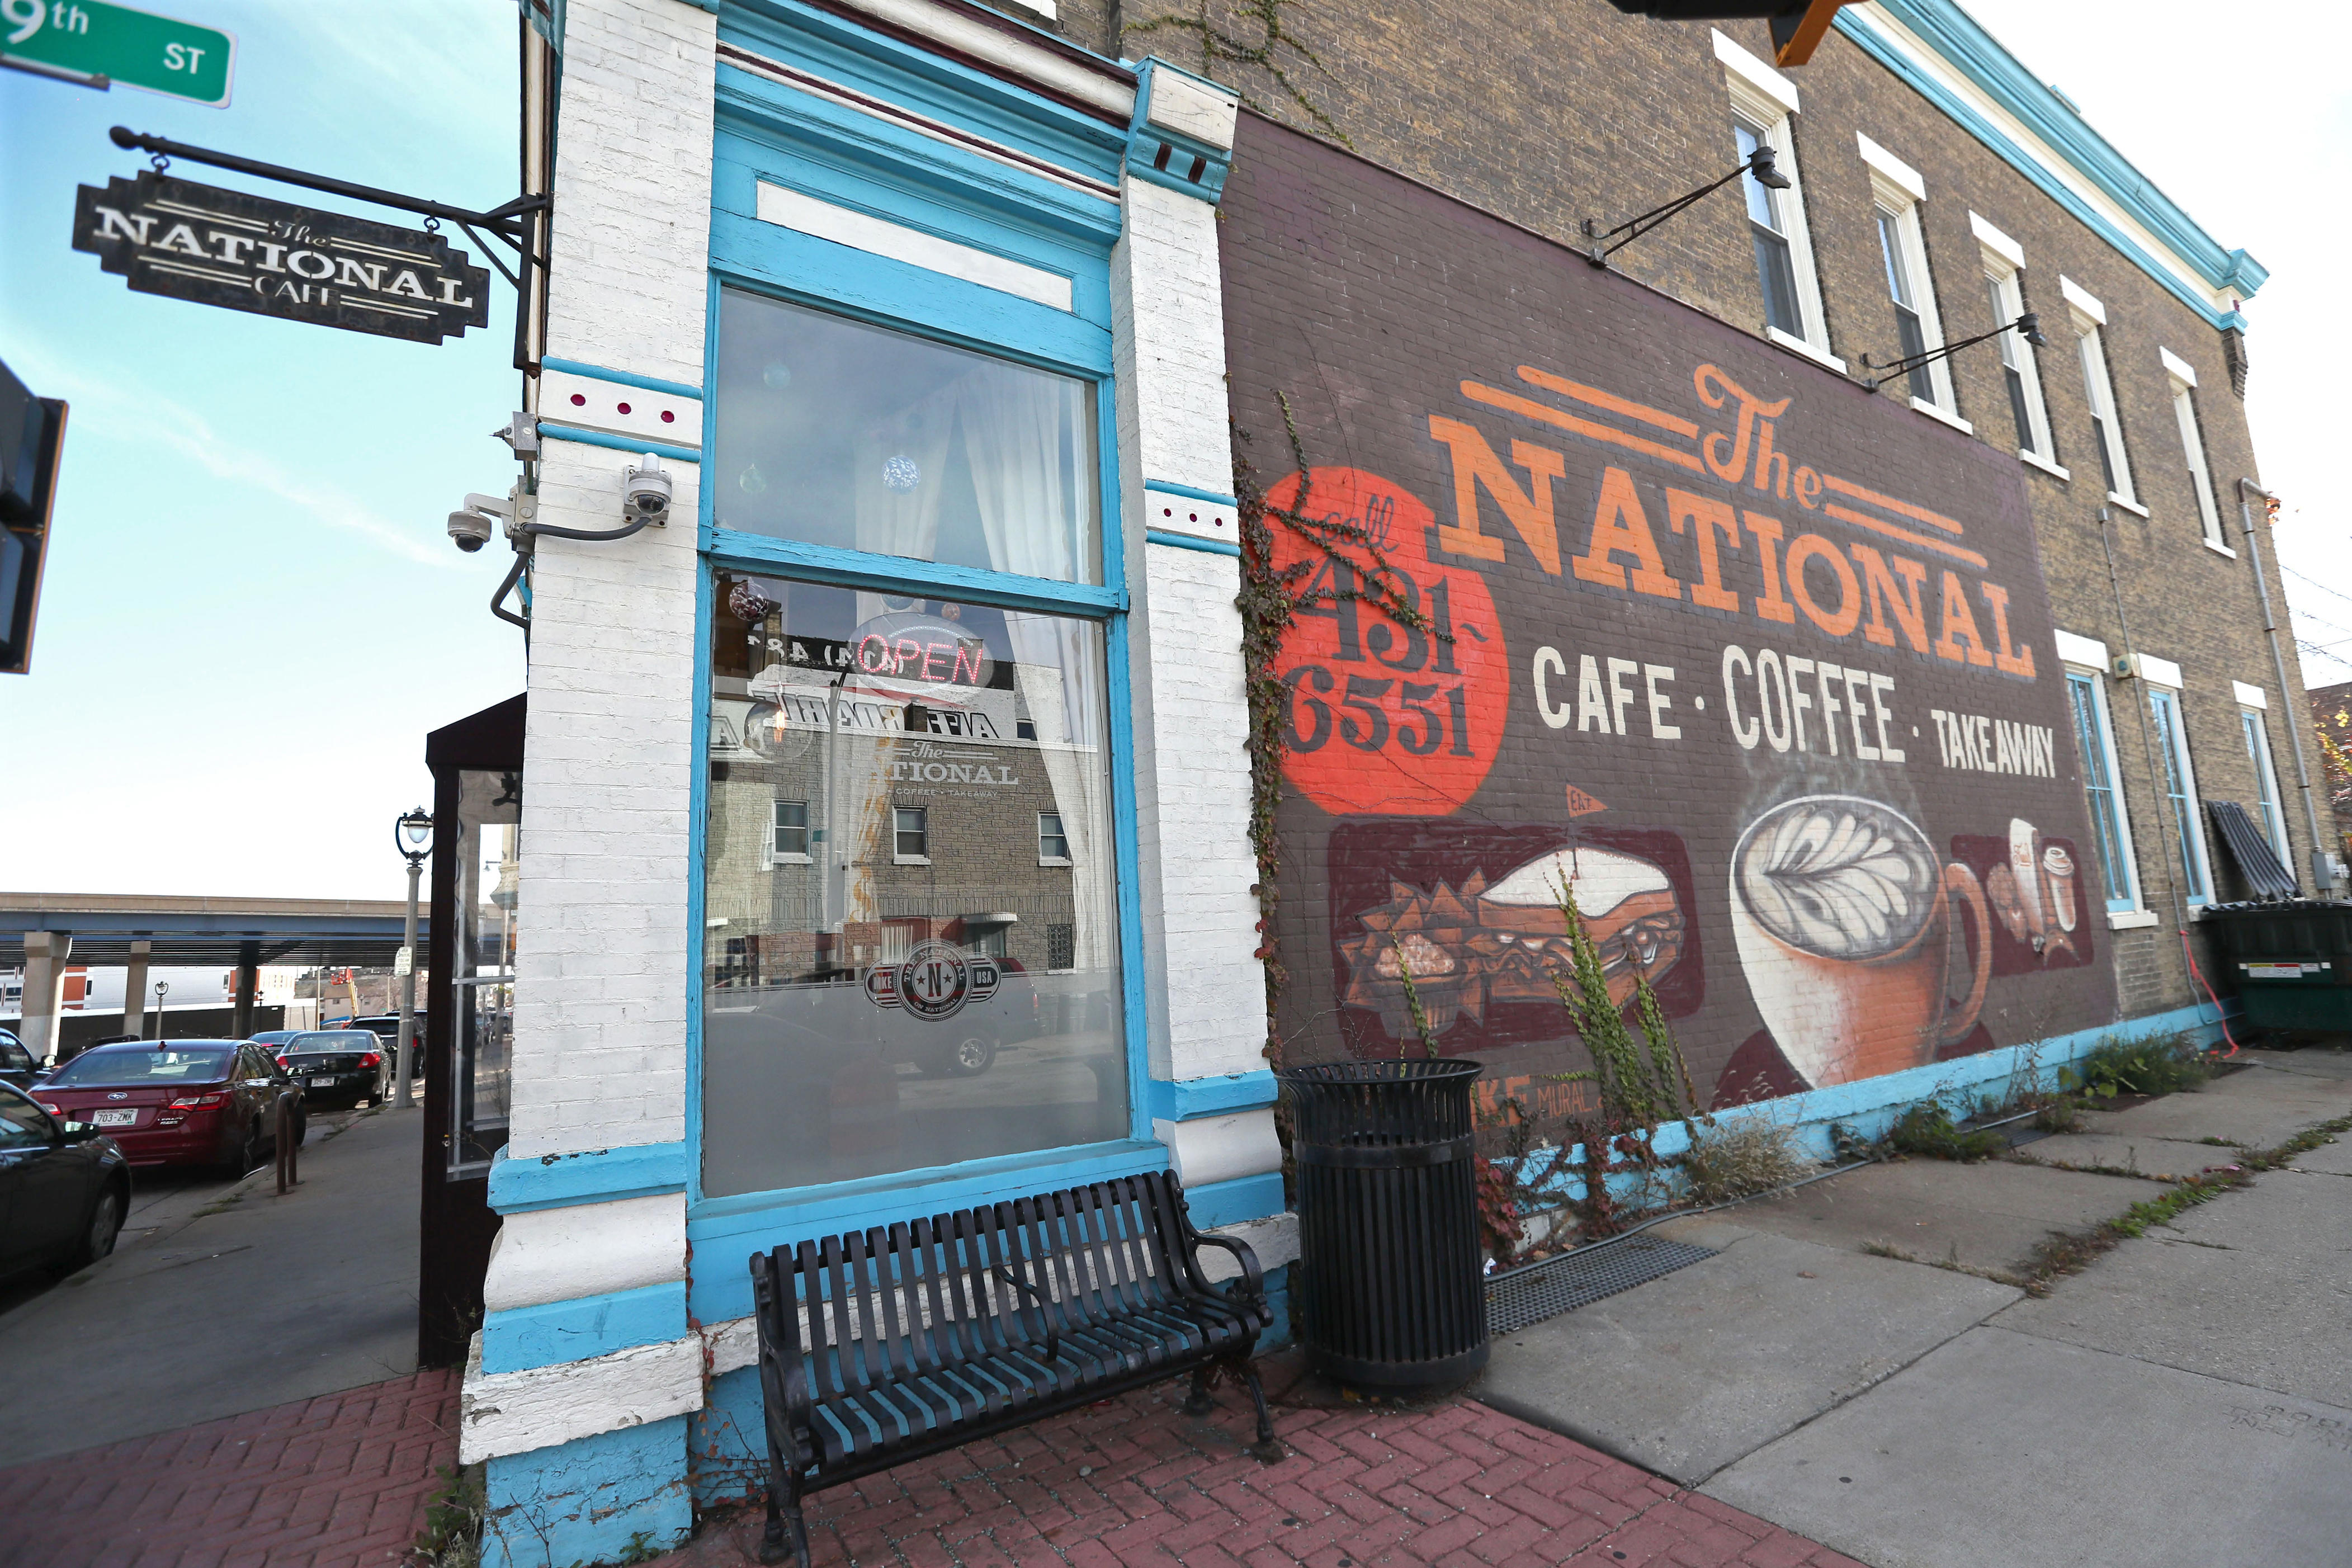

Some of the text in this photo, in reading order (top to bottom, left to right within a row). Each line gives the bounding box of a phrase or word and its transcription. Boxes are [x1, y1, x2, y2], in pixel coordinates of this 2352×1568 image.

[163, 42, 205, 74] ST
[271, 220, 327, 247] The
[93, 206, 473, 308] NATIONAL
[1693, 363, 1822, 509] The
[1321, 494, 1400, 552] call
[1428, 414, 2037, 678] NATIONAL
[858, 634, 983, 684] OPEN
[1279, 664, 1475, 758] 6551
[1533, 646, 1681, 739] CAFE
[1723, 645, 1905, 763] COFFEE
[911, 740, 943, 758] The
[1571, 790, 1591, 811] EAT
[873, 976, 892, 989] MKE
[904, 948, 966, 983] THE NATIONAL
[927, 963, 942, 998] N
[977, 971, 993, 984] USA
[914, 998, 958, 1013] ON NATIONAL
[98, 1113, 133, 1122] 703-ZMK
